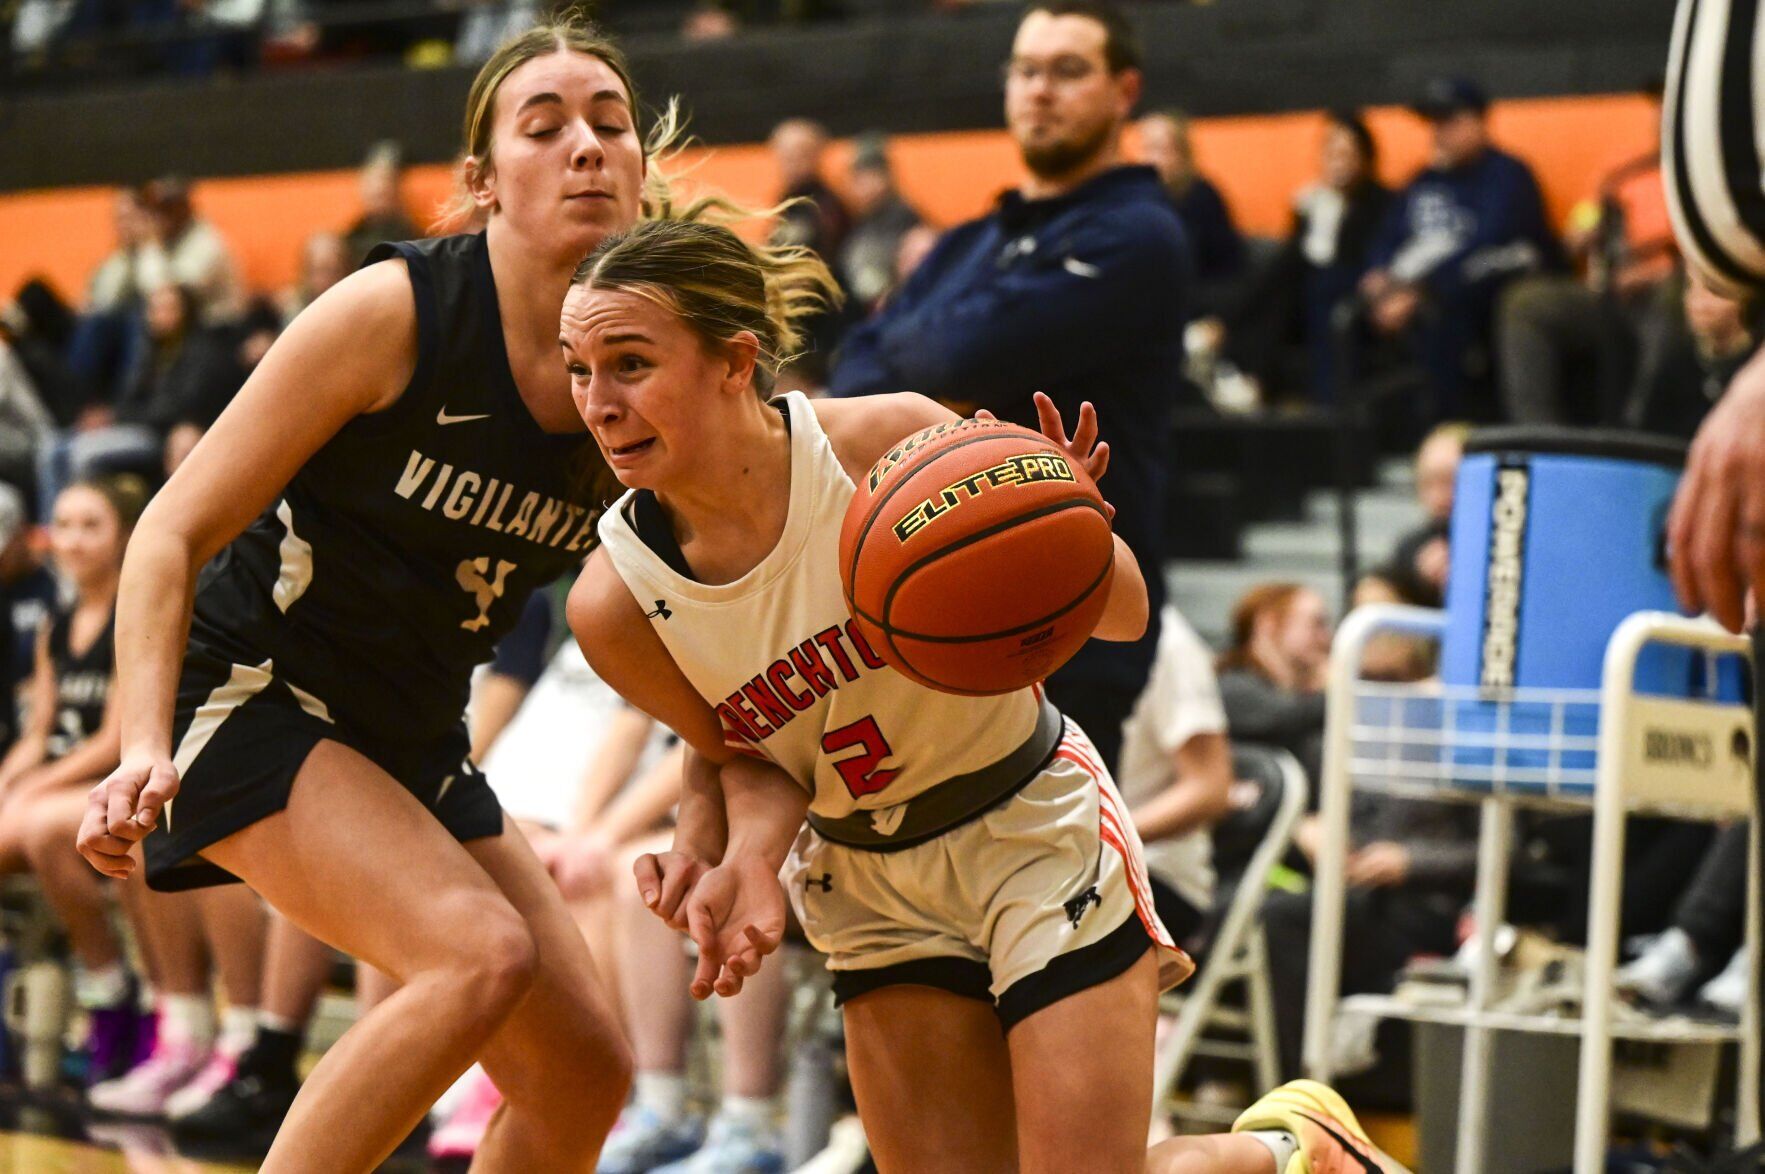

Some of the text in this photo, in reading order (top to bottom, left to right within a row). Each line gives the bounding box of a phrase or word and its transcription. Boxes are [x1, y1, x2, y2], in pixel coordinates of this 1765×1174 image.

[394, 449, 600, 551] VIGILANTE
[892, 462, 1024, 545] ELITE
[1020, 457, 1072, 480] PRO
[714, 618, 888, 743] RENCHTO
[820, 714, 905, 801] 2
